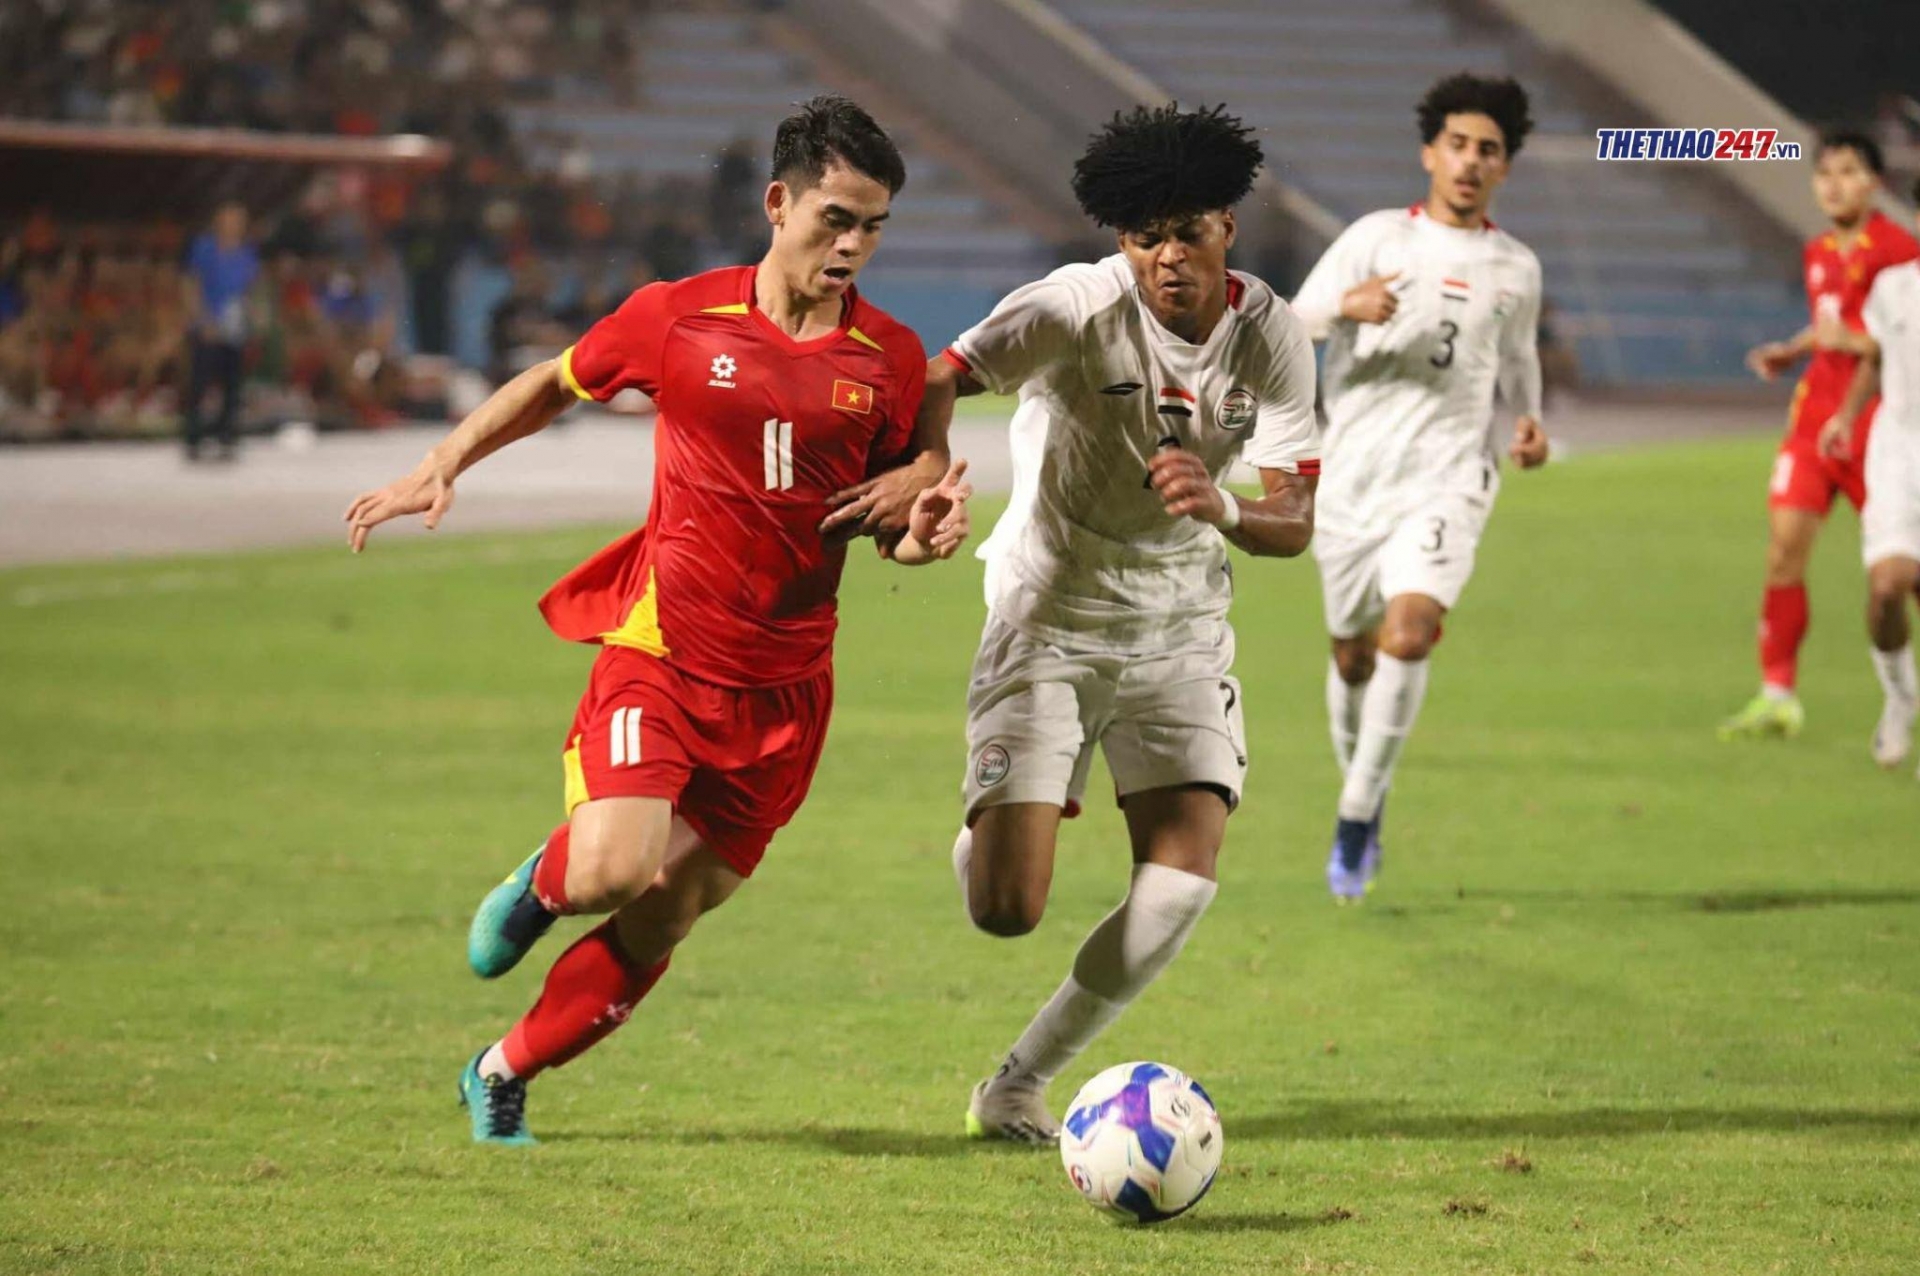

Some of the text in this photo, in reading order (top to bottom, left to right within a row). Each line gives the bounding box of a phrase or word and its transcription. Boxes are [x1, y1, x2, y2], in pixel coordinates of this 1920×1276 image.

[1431, 320, 1459, 369] 3
[763, 418, 794, 492] 11
[1420, 516, 1446, 553] 3
[610, 706, 643, 768] 11
